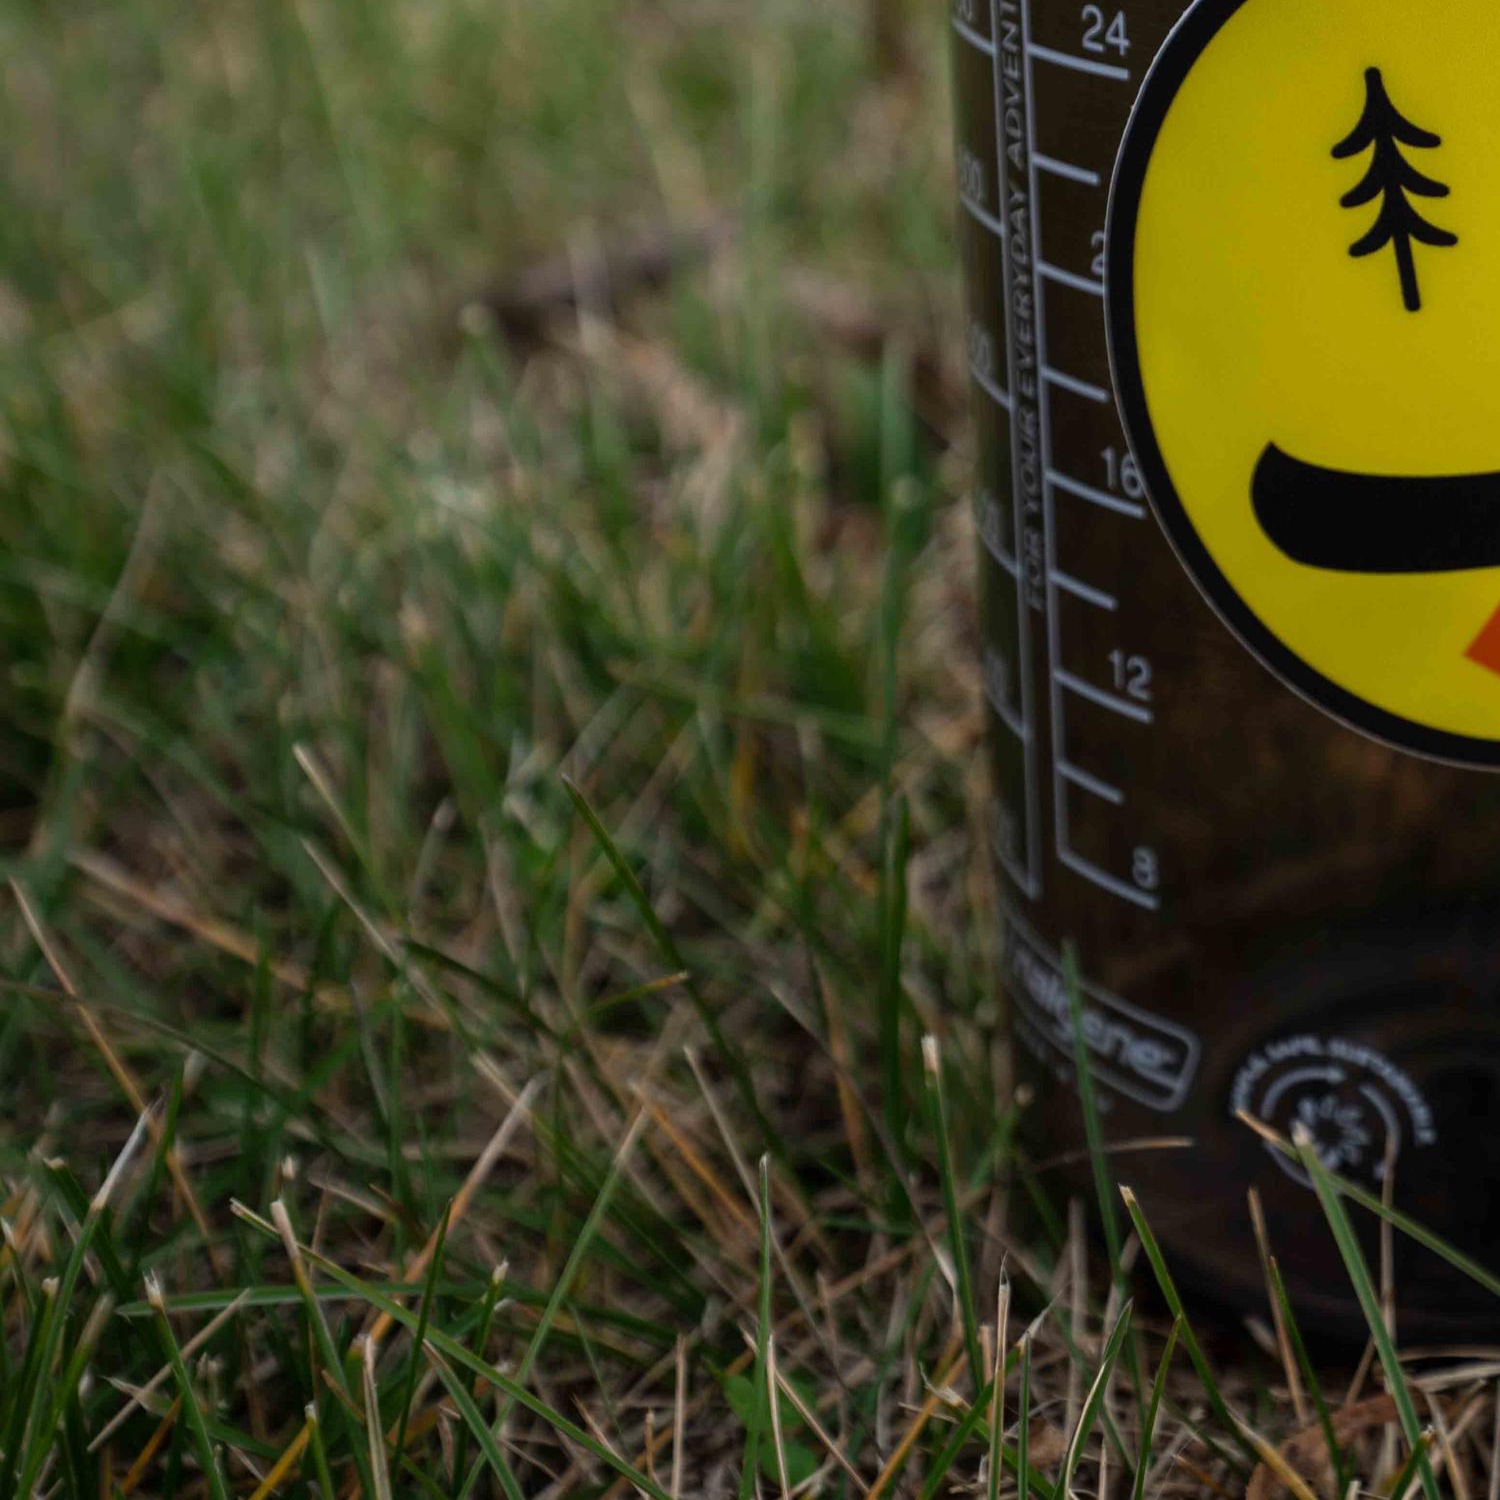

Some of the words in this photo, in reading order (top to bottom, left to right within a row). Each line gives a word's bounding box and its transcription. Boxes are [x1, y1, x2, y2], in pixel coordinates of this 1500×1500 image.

[1081, 4, 1131, 56] 24
[1007, 179, 1038, 397] EVERYDAY
[1018, 407, 1040, 513] YOUR
[1101, 446, 1146, 497] 16
[1107, 647, 1153, 701] 12
[1131, 844, 1160, 889] 8
